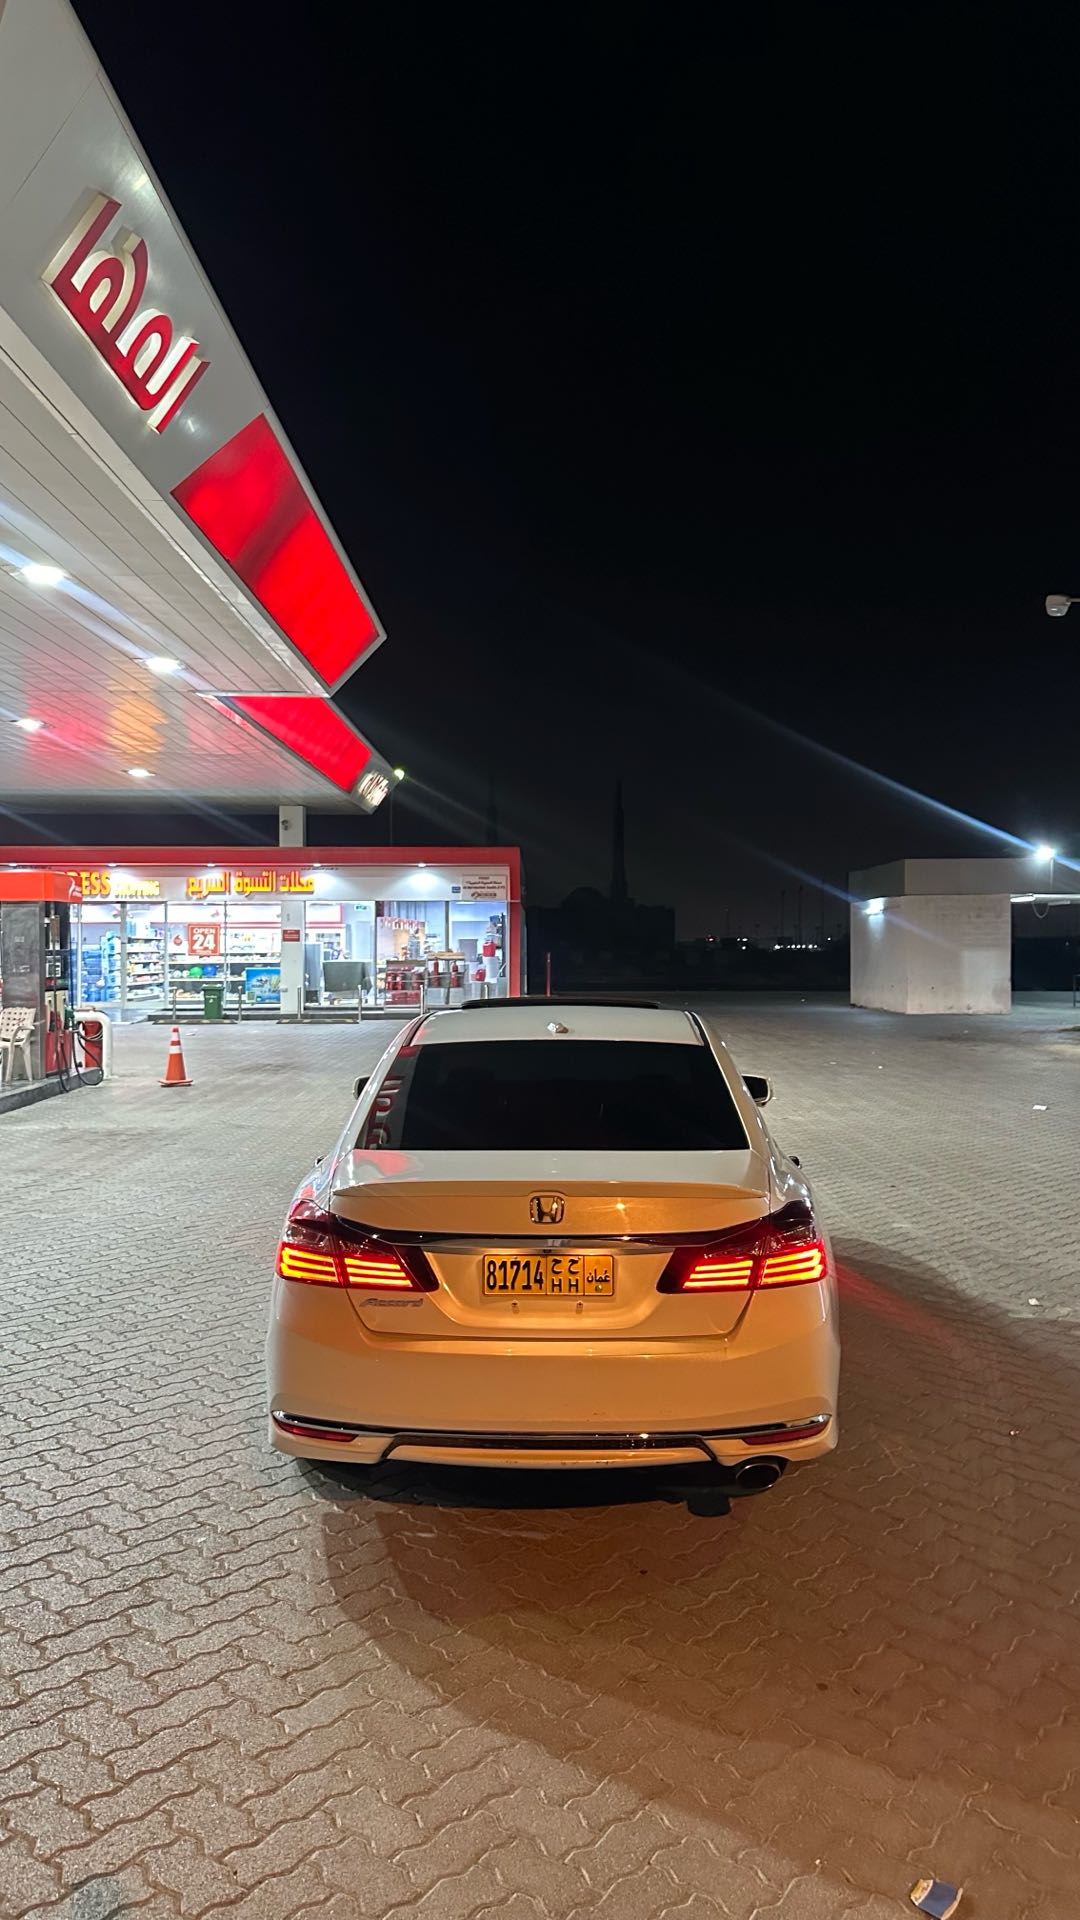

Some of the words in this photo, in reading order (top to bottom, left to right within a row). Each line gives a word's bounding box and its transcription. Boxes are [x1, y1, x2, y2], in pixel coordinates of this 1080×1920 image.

[42, 194, 210, 434] المها
[67, 871, 111, 896] ESS
[192, 934, 216, 950] 24
[486, 1260, 544, 1290] 81714
